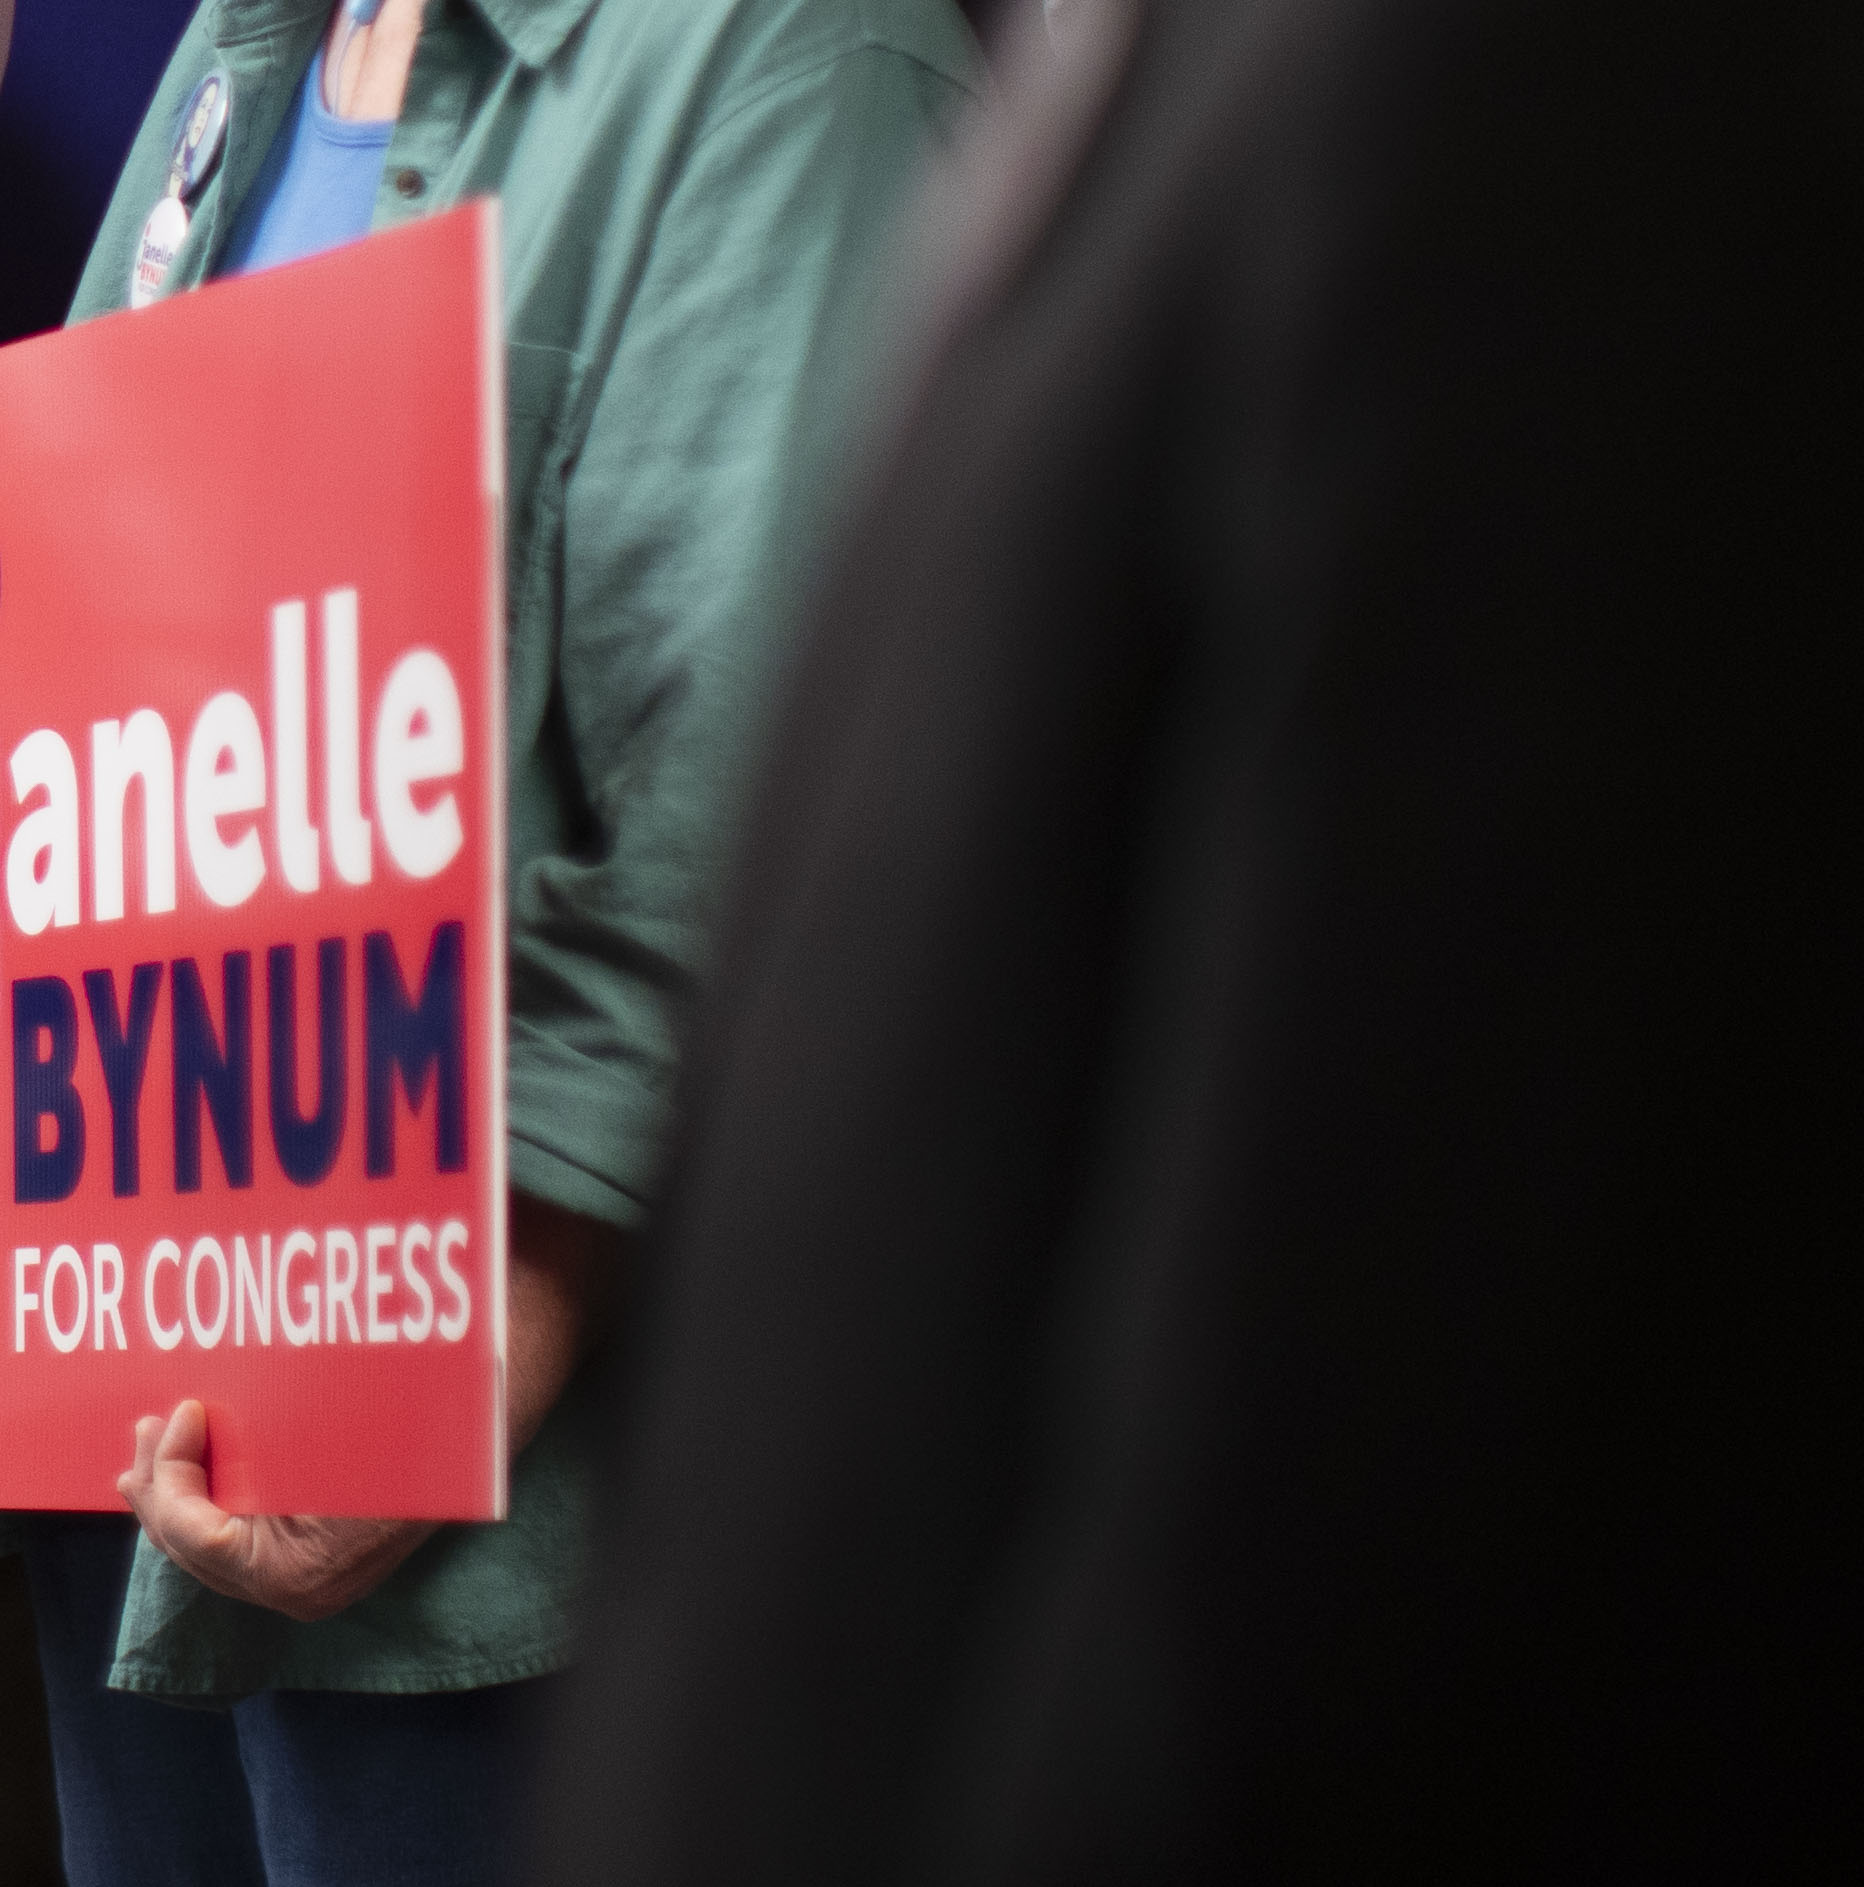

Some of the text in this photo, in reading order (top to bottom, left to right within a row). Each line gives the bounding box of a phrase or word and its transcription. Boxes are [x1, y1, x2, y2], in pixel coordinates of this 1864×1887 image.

[11, 921, 469, 1205] BYNUM
[12, 1221, 472, 1354] FOR CONGRESS
